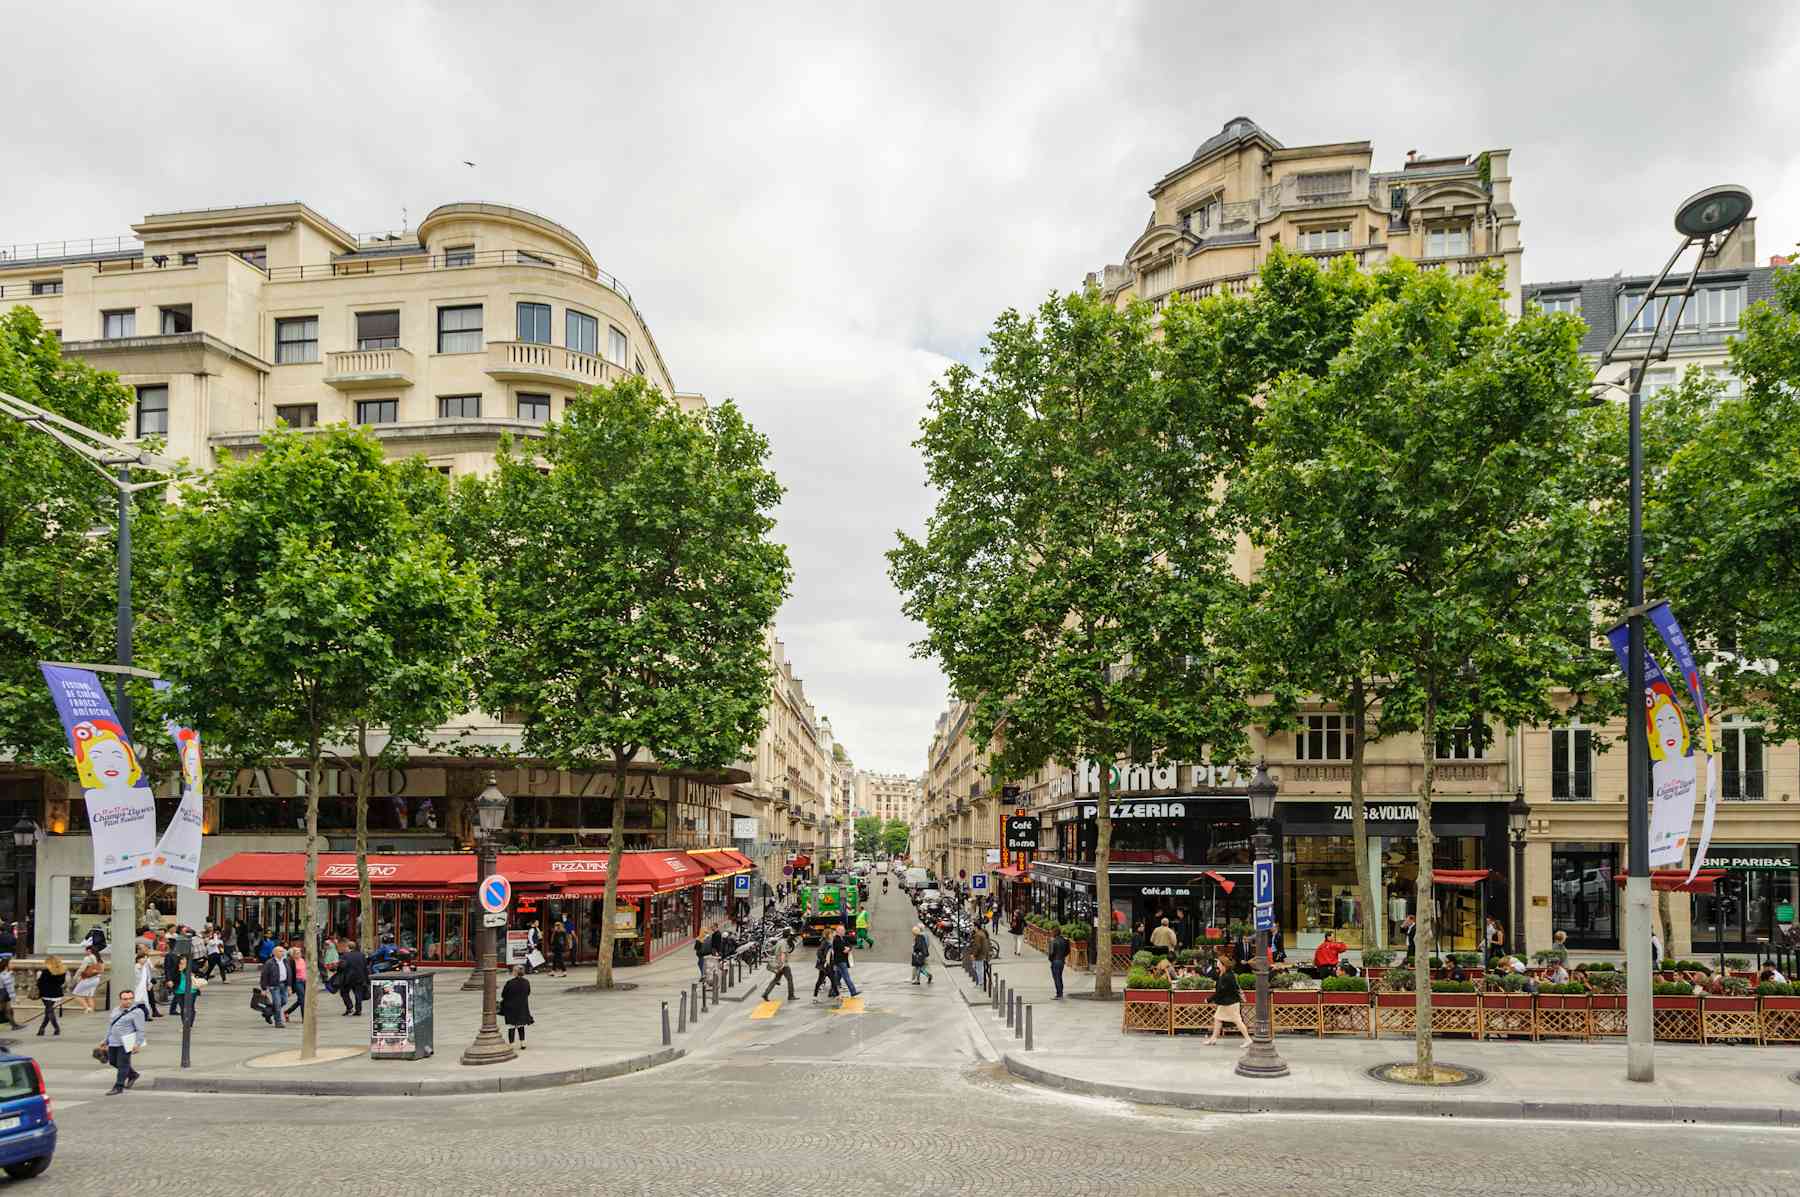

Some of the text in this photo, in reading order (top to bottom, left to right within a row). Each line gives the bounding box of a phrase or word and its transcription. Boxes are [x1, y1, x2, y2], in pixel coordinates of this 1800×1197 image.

[1011, 820, 1032, 830] Café
[1008, 839, 1036, 848] Roma
[551, 863, 585, 871] PIZZA
[1702, 858, 1792, 867] BNP PARIBAS
[1260, 869, 1269, 897] P
[1141, 887, 1160, 895] Café
